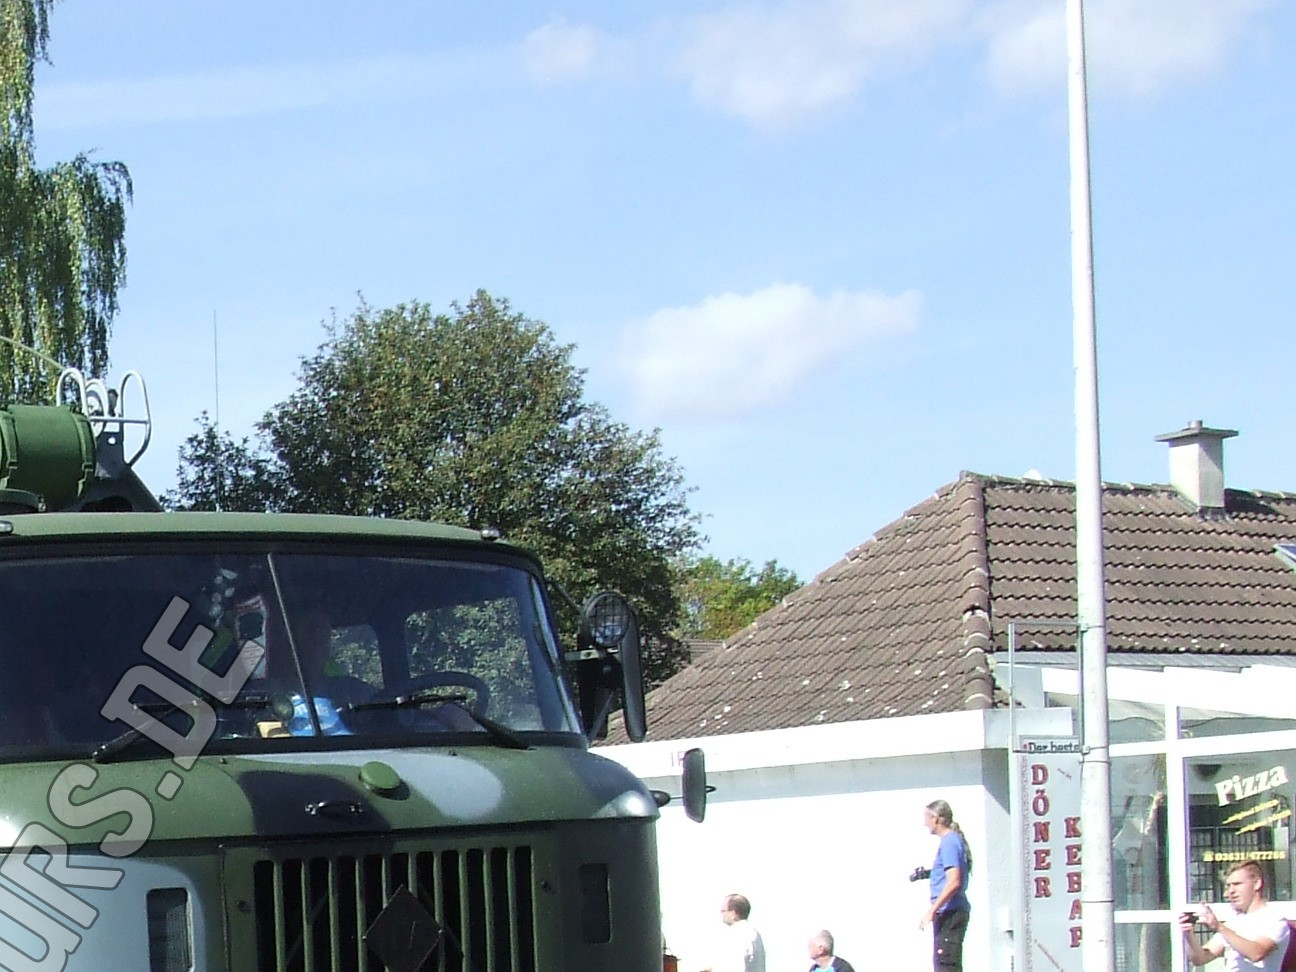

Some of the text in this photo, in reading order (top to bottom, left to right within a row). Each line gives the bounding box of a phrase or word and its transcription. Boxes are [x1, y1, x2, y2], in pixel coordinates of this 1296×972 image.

[1031, 764, 1051, 898] DÖNER
[1215, 766, 1288, 806] Pizza
[1064, 816, 1082, 948] KEBAP
